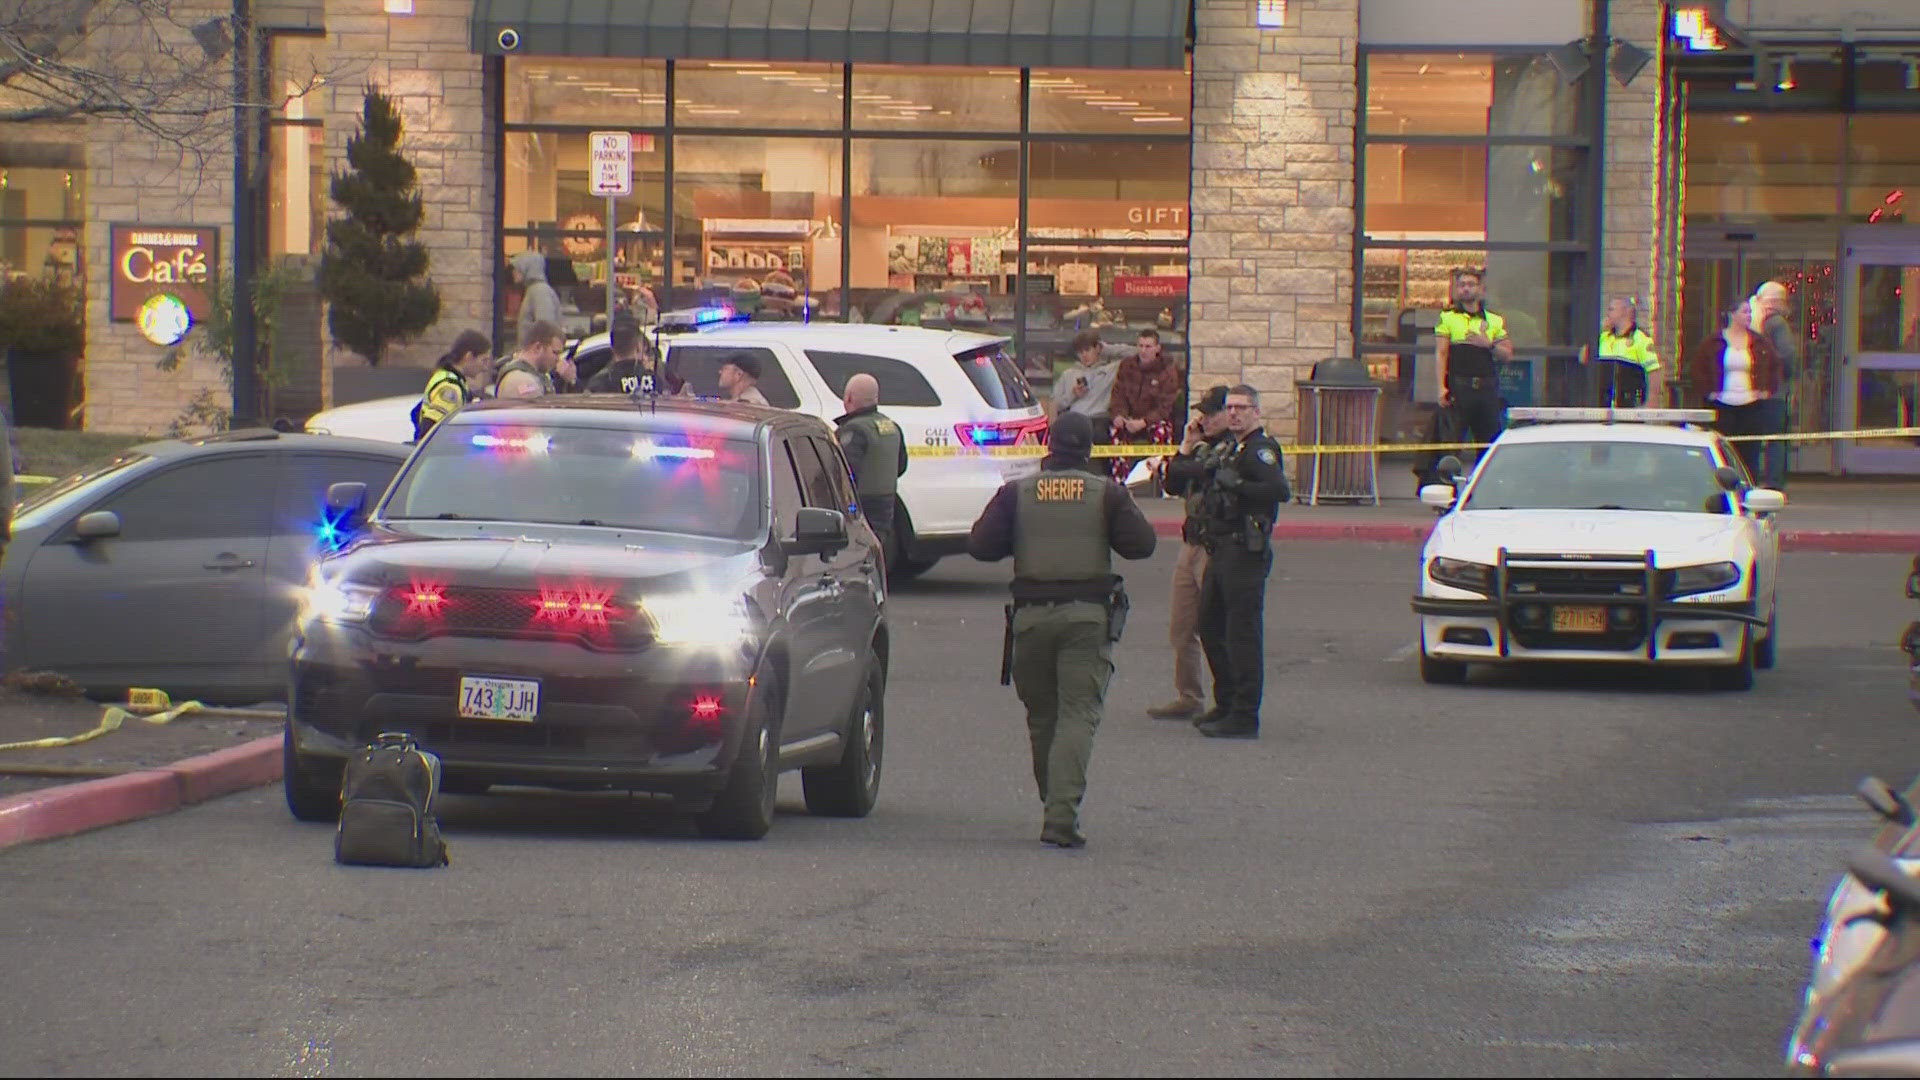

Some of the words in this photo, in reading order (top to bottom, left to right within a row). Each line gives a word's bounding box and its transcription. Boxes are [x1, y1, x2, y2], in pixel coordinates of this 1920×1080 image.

[603, 137, 617, 149] NO
[594, 150, 626, 161] PARKING
[602, 163, 618, 171] ANY
[601, 172, 618, 180] TIME
[1128, 207, 1183, 224] GIFT
[122, 246, 207, 283] Café
[925, 428, 949, 436] CALL
[925, 437, 949, 447] 911
[1036, 478, 1084, 501] SHERIFF
[464, 686, 493, 709] 743
[505, 690, 534, 712] JJH
